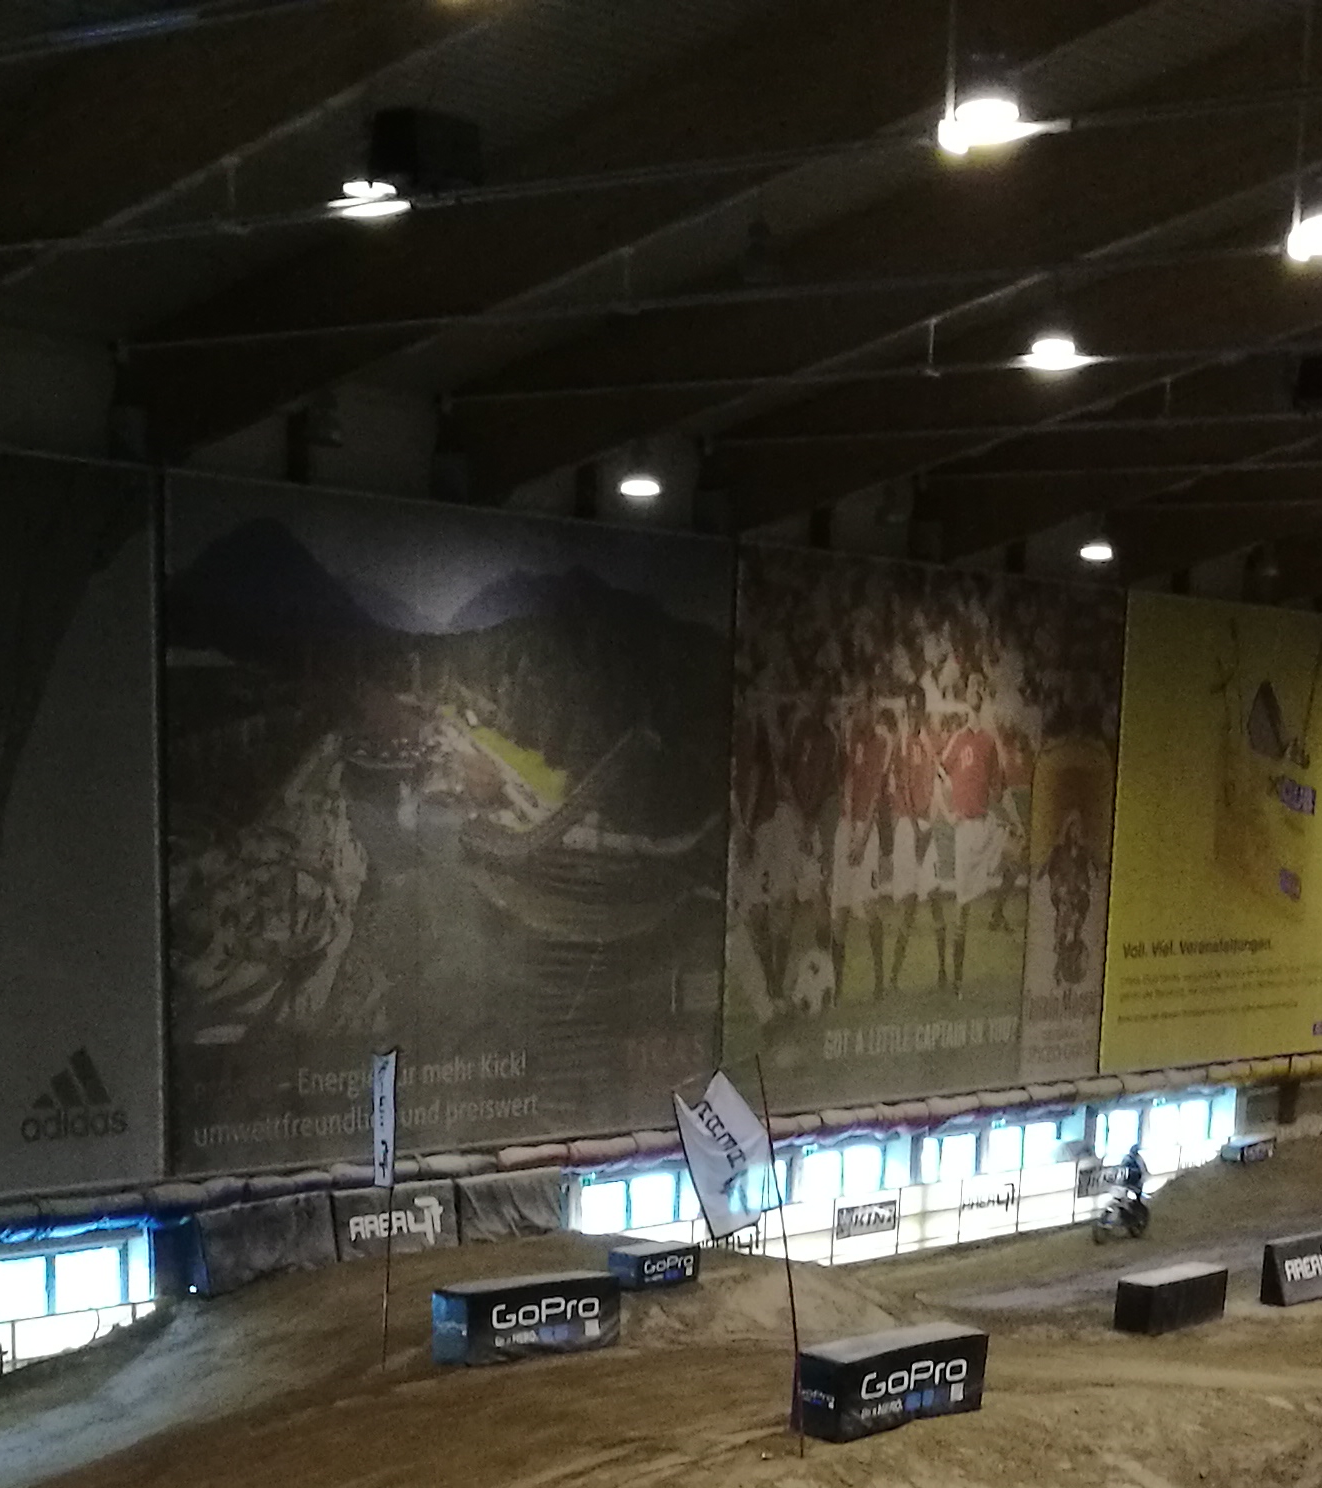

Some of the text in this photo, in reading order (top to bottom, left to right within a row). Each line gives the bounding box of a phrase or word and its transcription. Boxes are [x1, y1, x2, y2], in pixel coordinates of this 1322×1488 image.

[480, 1051, 528, 1078] Kick!
[20, 1108, 128, 1143] adidas
[349, 1196, 444, 1245] AREA47
[644, 1253, 695, 1276] GoPro
[492, 1296, 600, 1331] GoPro
[861, 1357, 968, 1400] GoPro
